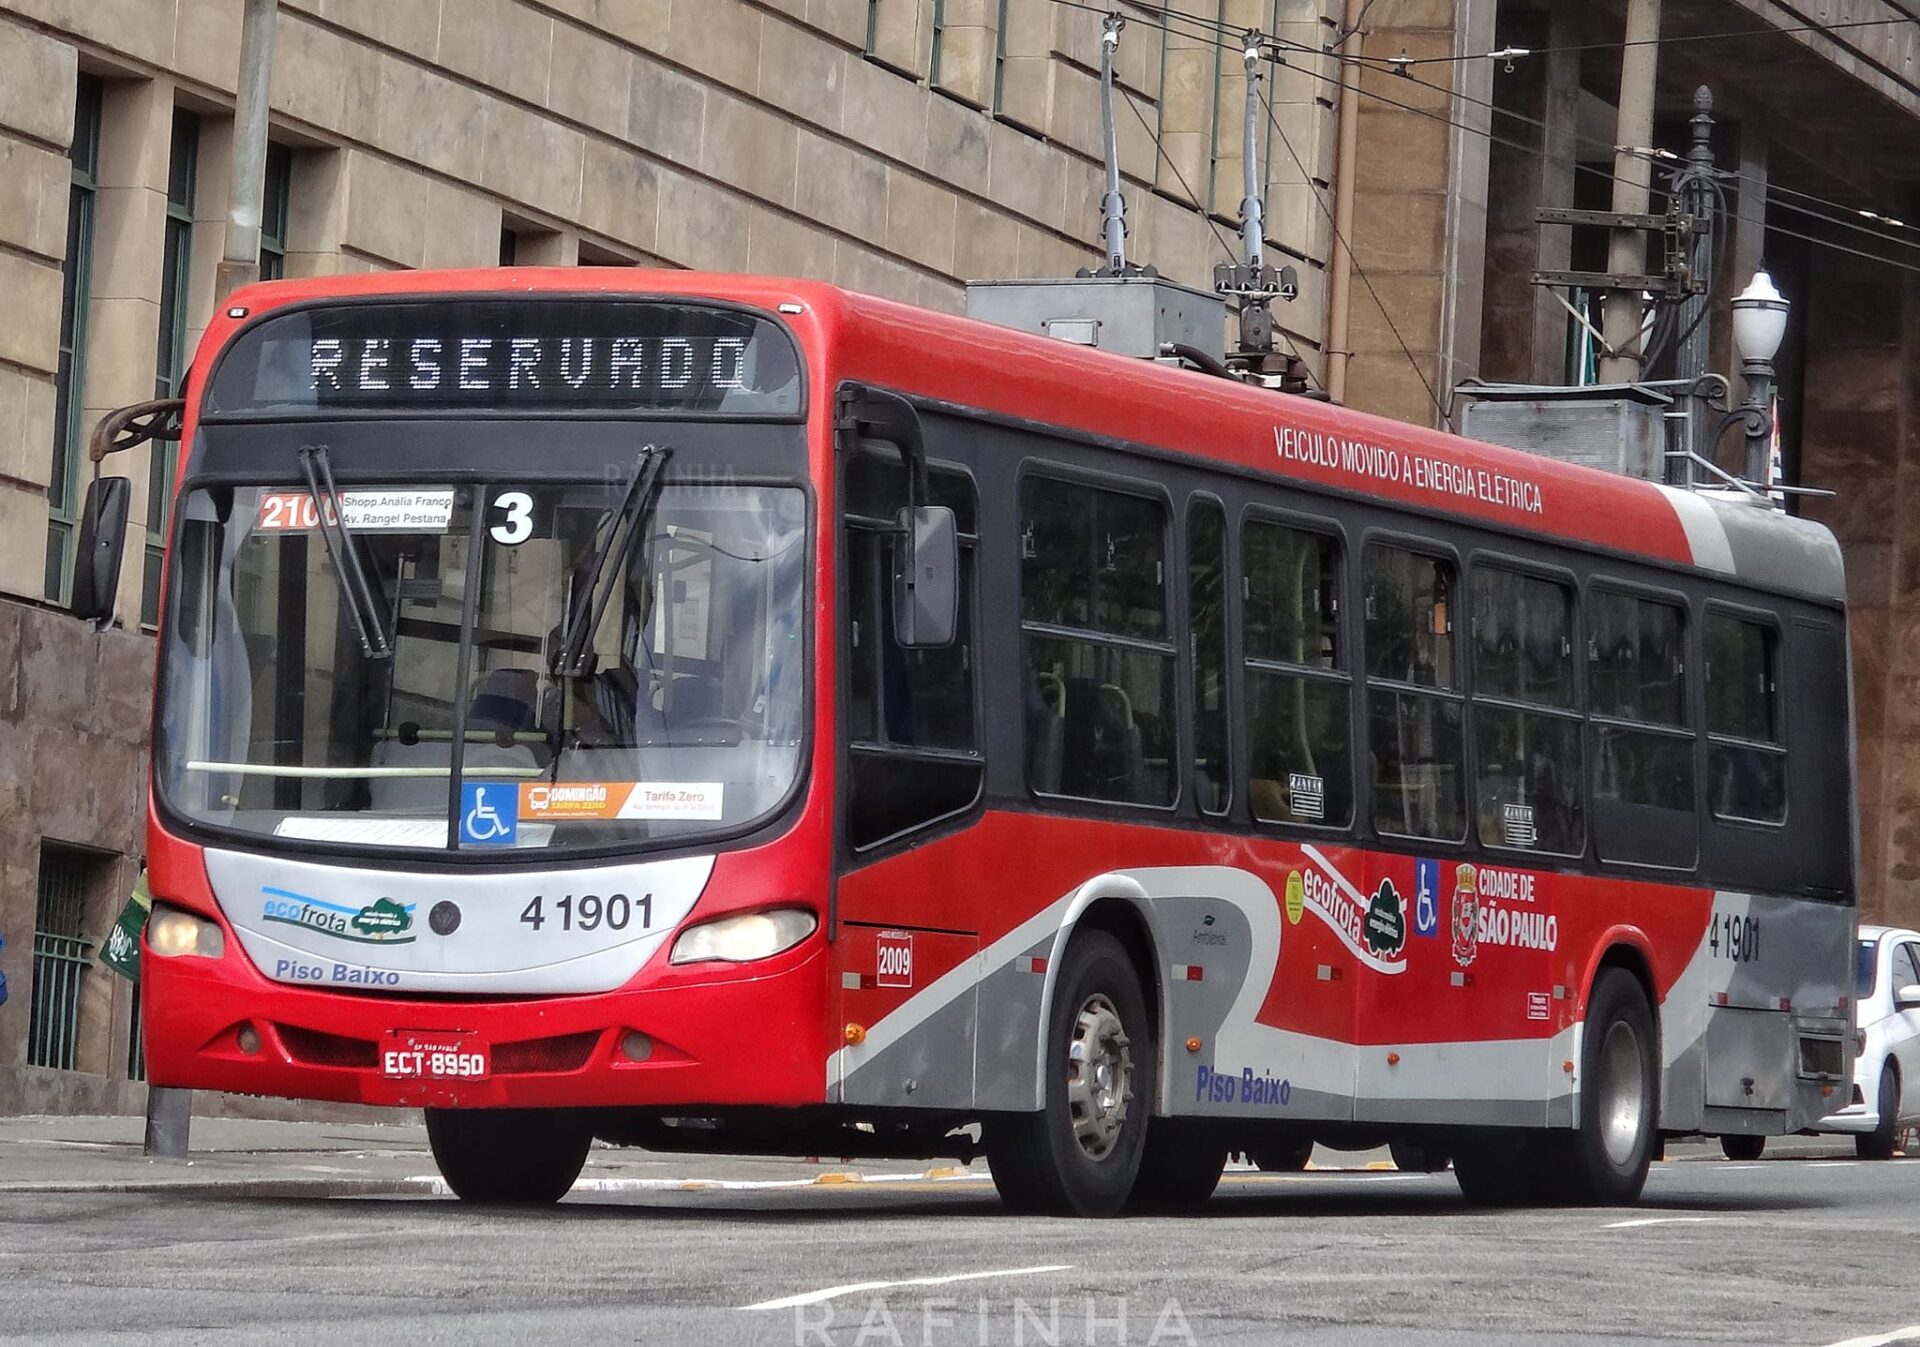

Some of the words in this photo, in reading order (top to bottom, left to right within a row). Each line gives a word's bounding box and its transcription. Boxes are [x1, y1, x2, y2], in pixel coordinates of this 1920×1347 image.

[310, 337, 746, 391] RESERVADO
[1273, 425, 1339, 468] VEICULO
[1341, 440, 1400, 481] MOVIDO
[1403, 455, 1413, 486] A
[1415, 457, 1477, 498] ENERGIA
[1478, 467, 1543, 514] ELÉTRICA
[344, 514, 360, 524] Av.
[362, 513, 400, 526] Rangel
[403, 513, 447, 524] Pestana
[490, 491, 534, 545] 3
[551, 784, 607, 802] DOMINGÃO
[644, 791, 676, 802] Tarifa
[679, 791, 705, 802] Zero
[1478, 868, 1518, 899] CIDADE
[1520, 874, 1535, 902] DE
[263, 897, 347, 934] ecofrota
[1303, 868, 1361, 945] ecofrota
[1477, 900, 1510, 946] SÃO
[1510, 910, 1558, 952] PAULO
[275, 959, 324, 980] Piso
[331, 965, 400, 986] Baixo
[879, 946, 911, 976] 2009
[1197, 1065, 1235, 1103] Piso
[1242, 1068, 1290, 1107] Baixo
